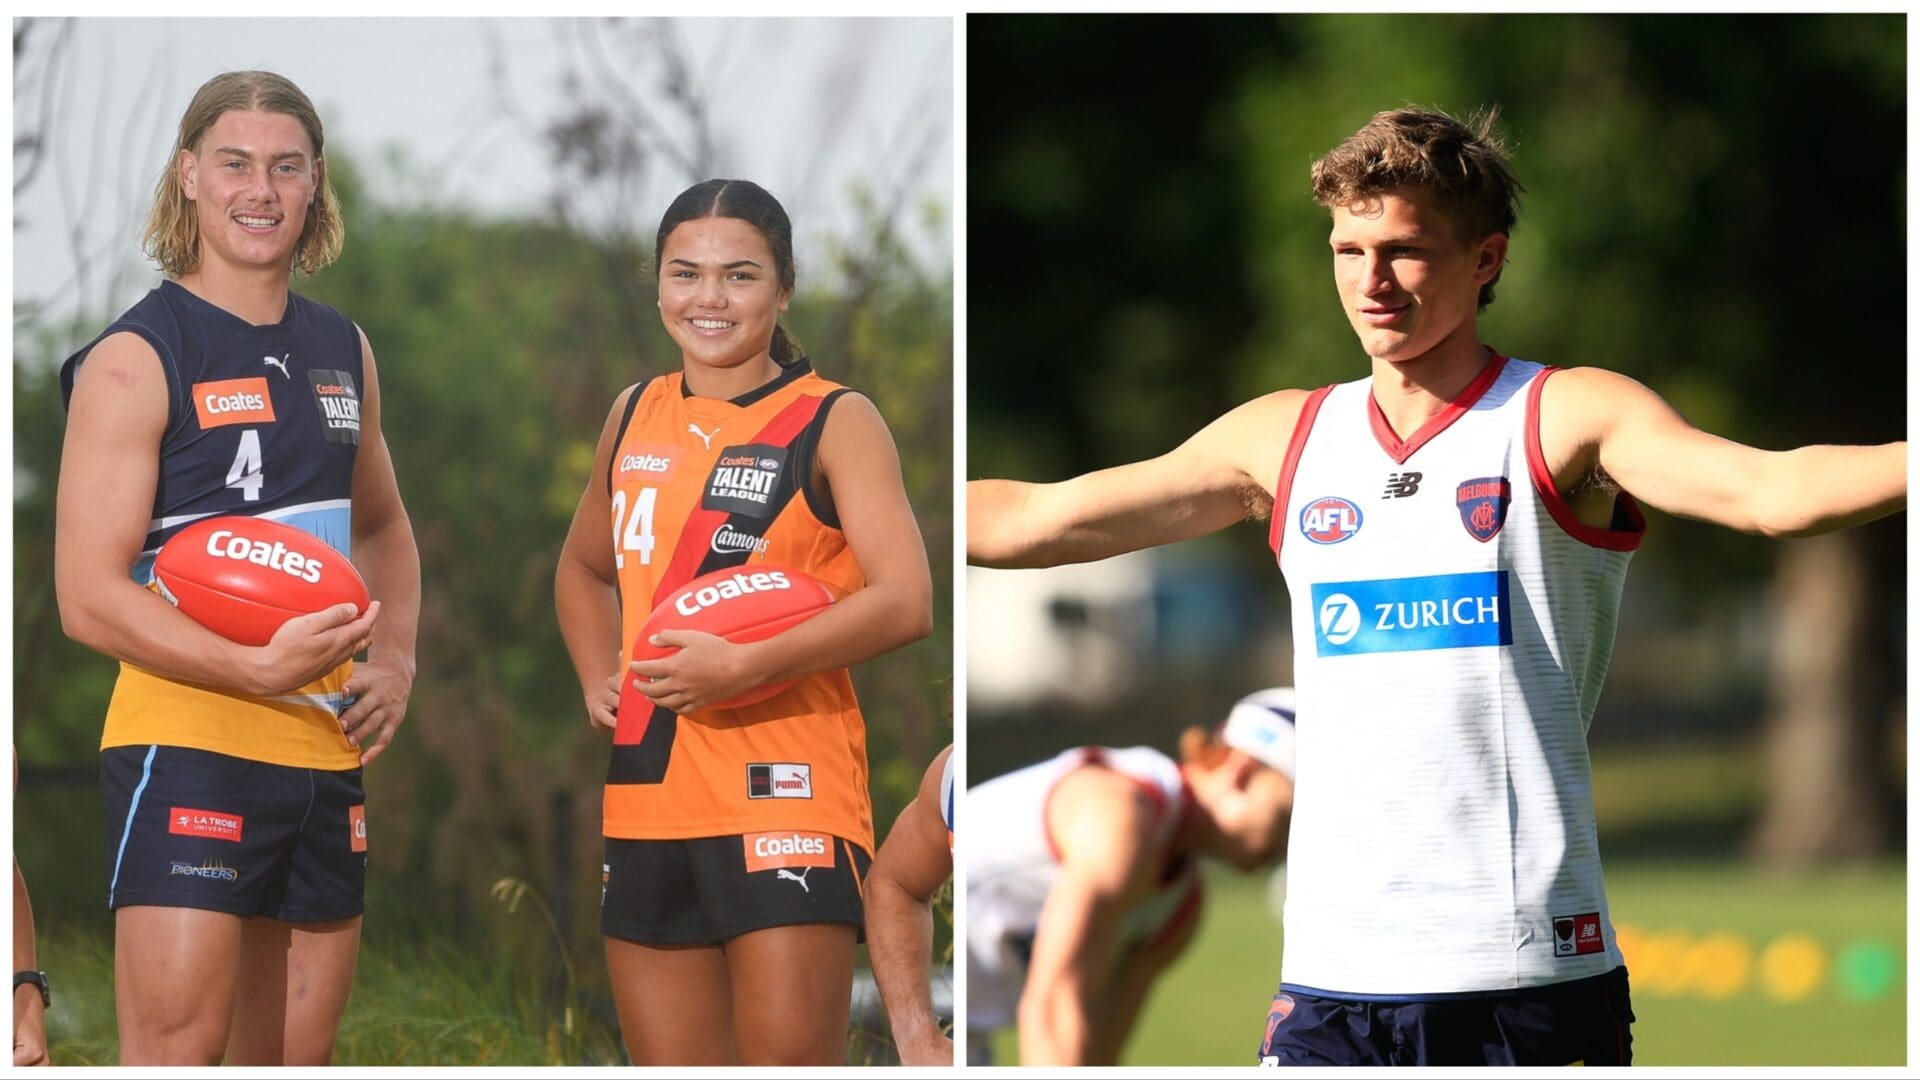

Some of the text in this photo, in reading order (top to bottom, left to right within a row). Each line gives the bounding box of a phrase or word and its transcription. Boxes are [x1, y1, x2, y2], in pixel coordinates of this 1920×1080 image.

[205, 392, 264, 413] Coates
[320, 396, 360, 421] TALENT
[226, 429, 263, 501] 4
[621, 454, 670, 472] Coates
[720, 456, 755, 466] Coates
[713, 467, 776, 494] TALENT
[710, 487, 768, 503] LEAGUE
[612, 487, 657, 570] 24
[1304, 507, 1358, 534] AFL
[711, 523, 770, 560] Cannons
[207, 531, 323, 583] Coates
[675, 571, 791, 616] Coates
[1375, 596, 1500, 631] ZURICH
[193, 816, 238, 829] LA TROBE
[193, 824, 237, 834] UNIVERSITY
[754, 835, 825, 858] Coates
[171, 864, 234, 881] PIONEERS
